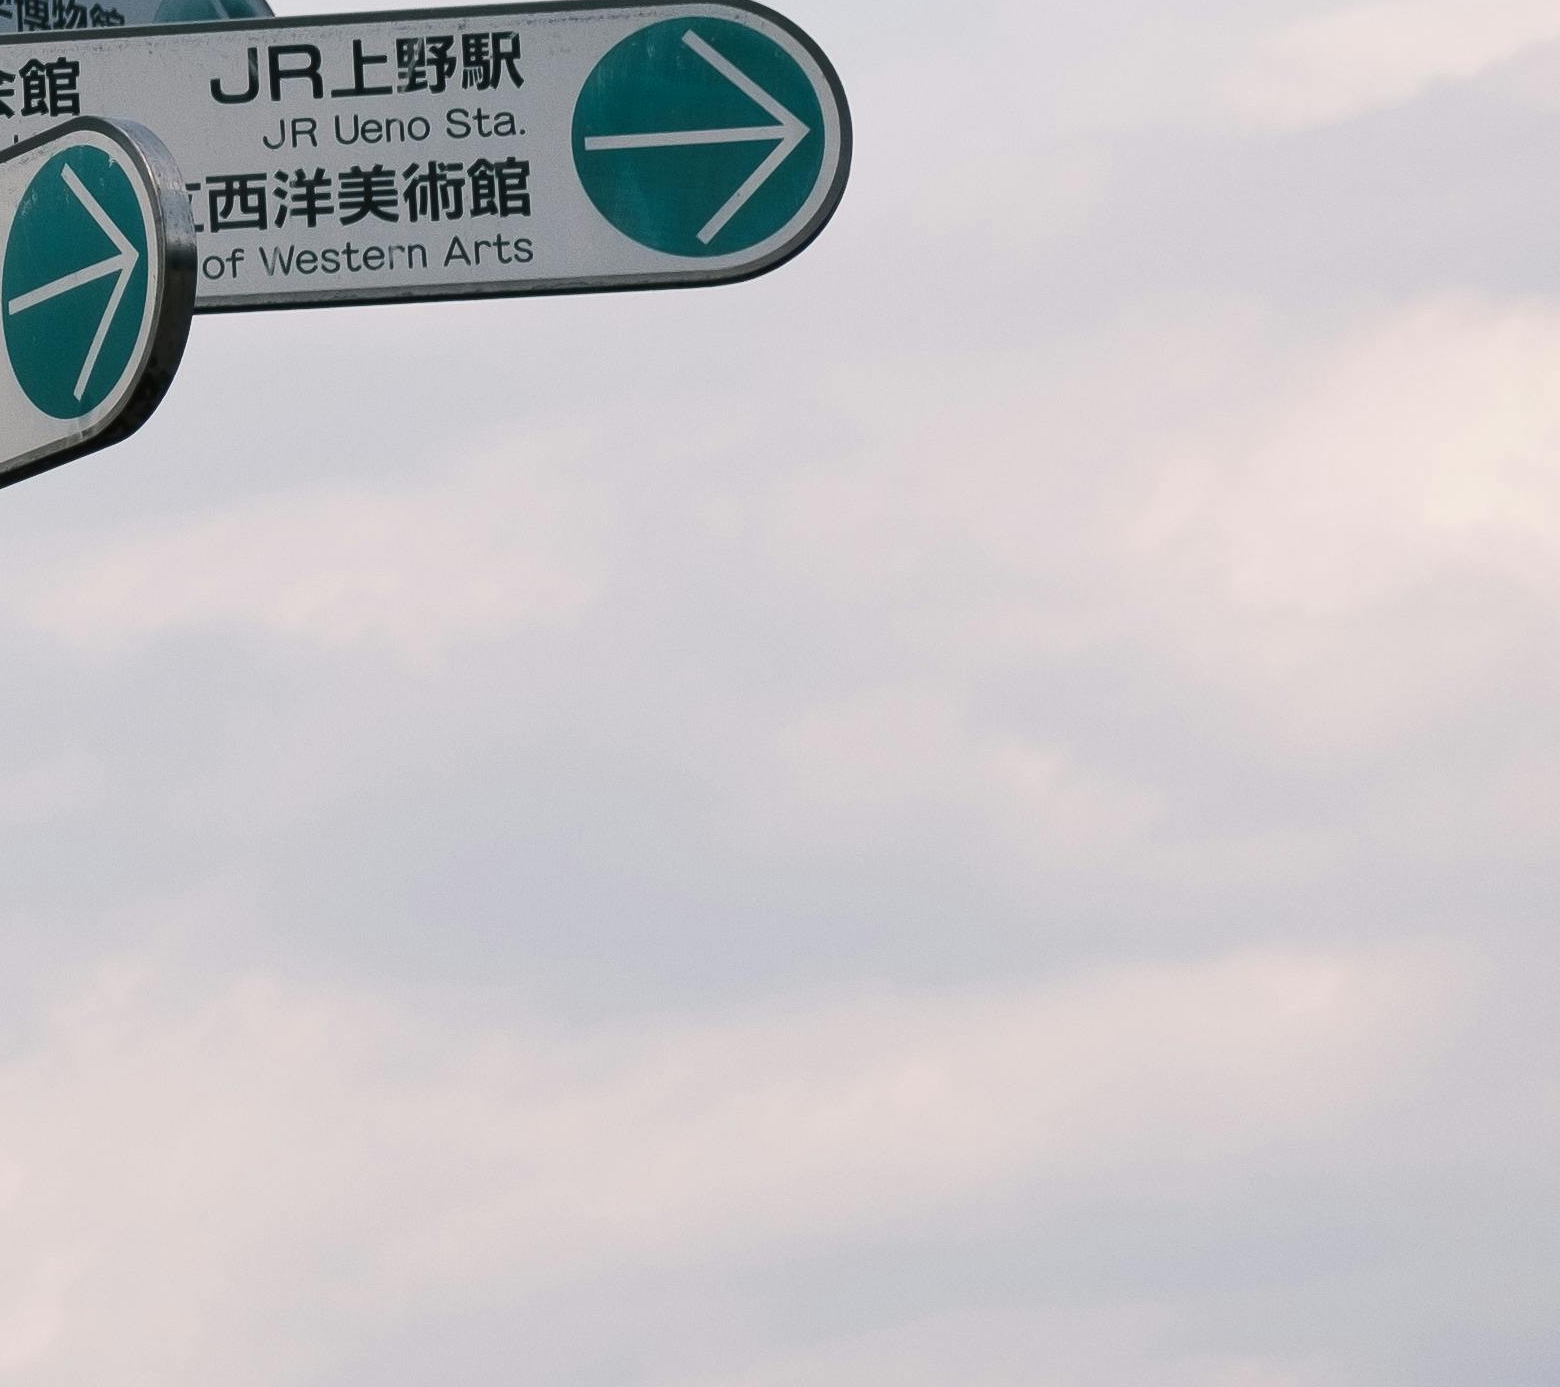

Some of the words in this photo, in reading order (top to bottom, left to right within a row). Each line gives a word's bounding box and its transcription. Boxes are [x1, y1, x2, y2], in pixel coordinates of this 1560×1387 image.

[210, 31, 525, 104] JR上野駅
[262, 116, 318, 150] JR
[334, 114, 431, 145] Ueno
[446, 107, 526, 139] Sta.
[202, 247, 245, 280] of
[258, 241, 428, 276] Western
[443, 233, 534, 267] Arts
